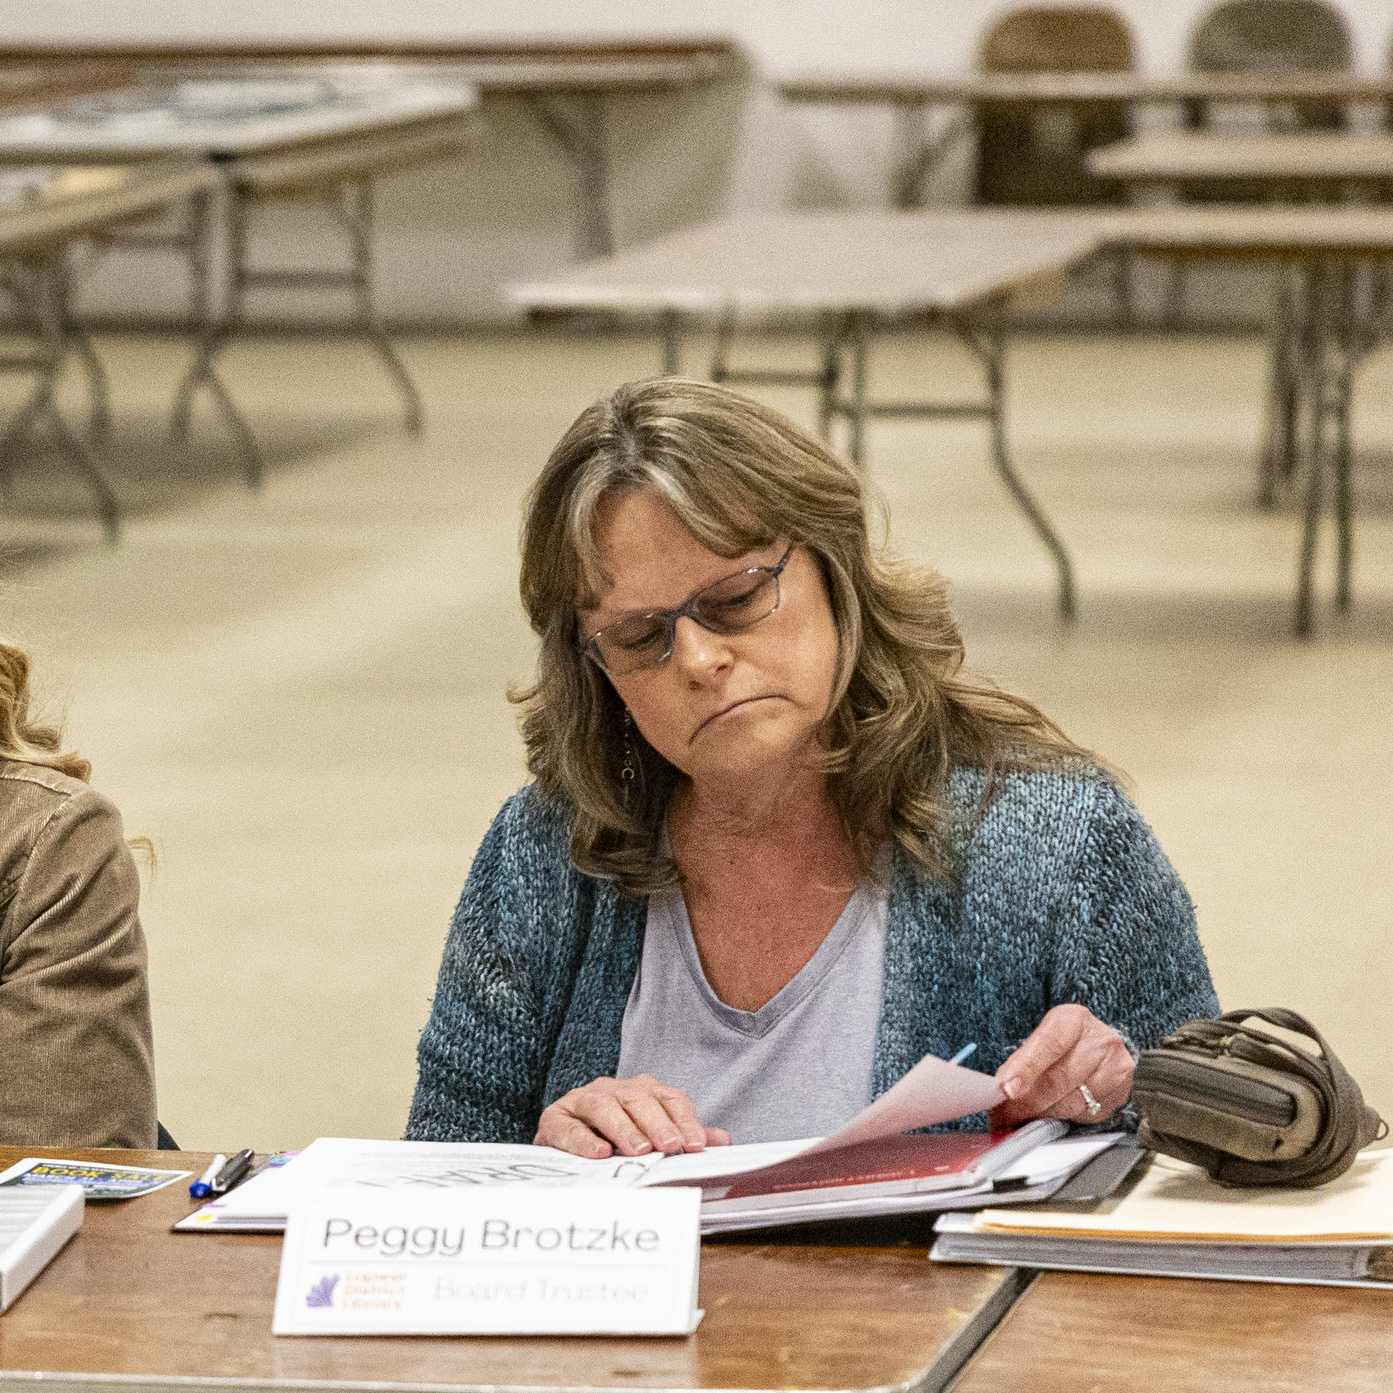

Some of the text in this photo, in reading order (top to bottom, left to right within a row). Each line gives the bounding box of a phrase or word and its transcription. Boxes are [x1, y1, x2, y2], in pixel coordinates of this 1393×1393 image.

[31, 1166, 105, 1178] BOOK
[112, 1173, 170, 1182] SALE
[323, 1218, 660, 1256] Peggy Brotzke
[434, 1276, 650, 1302] Board Trustee
